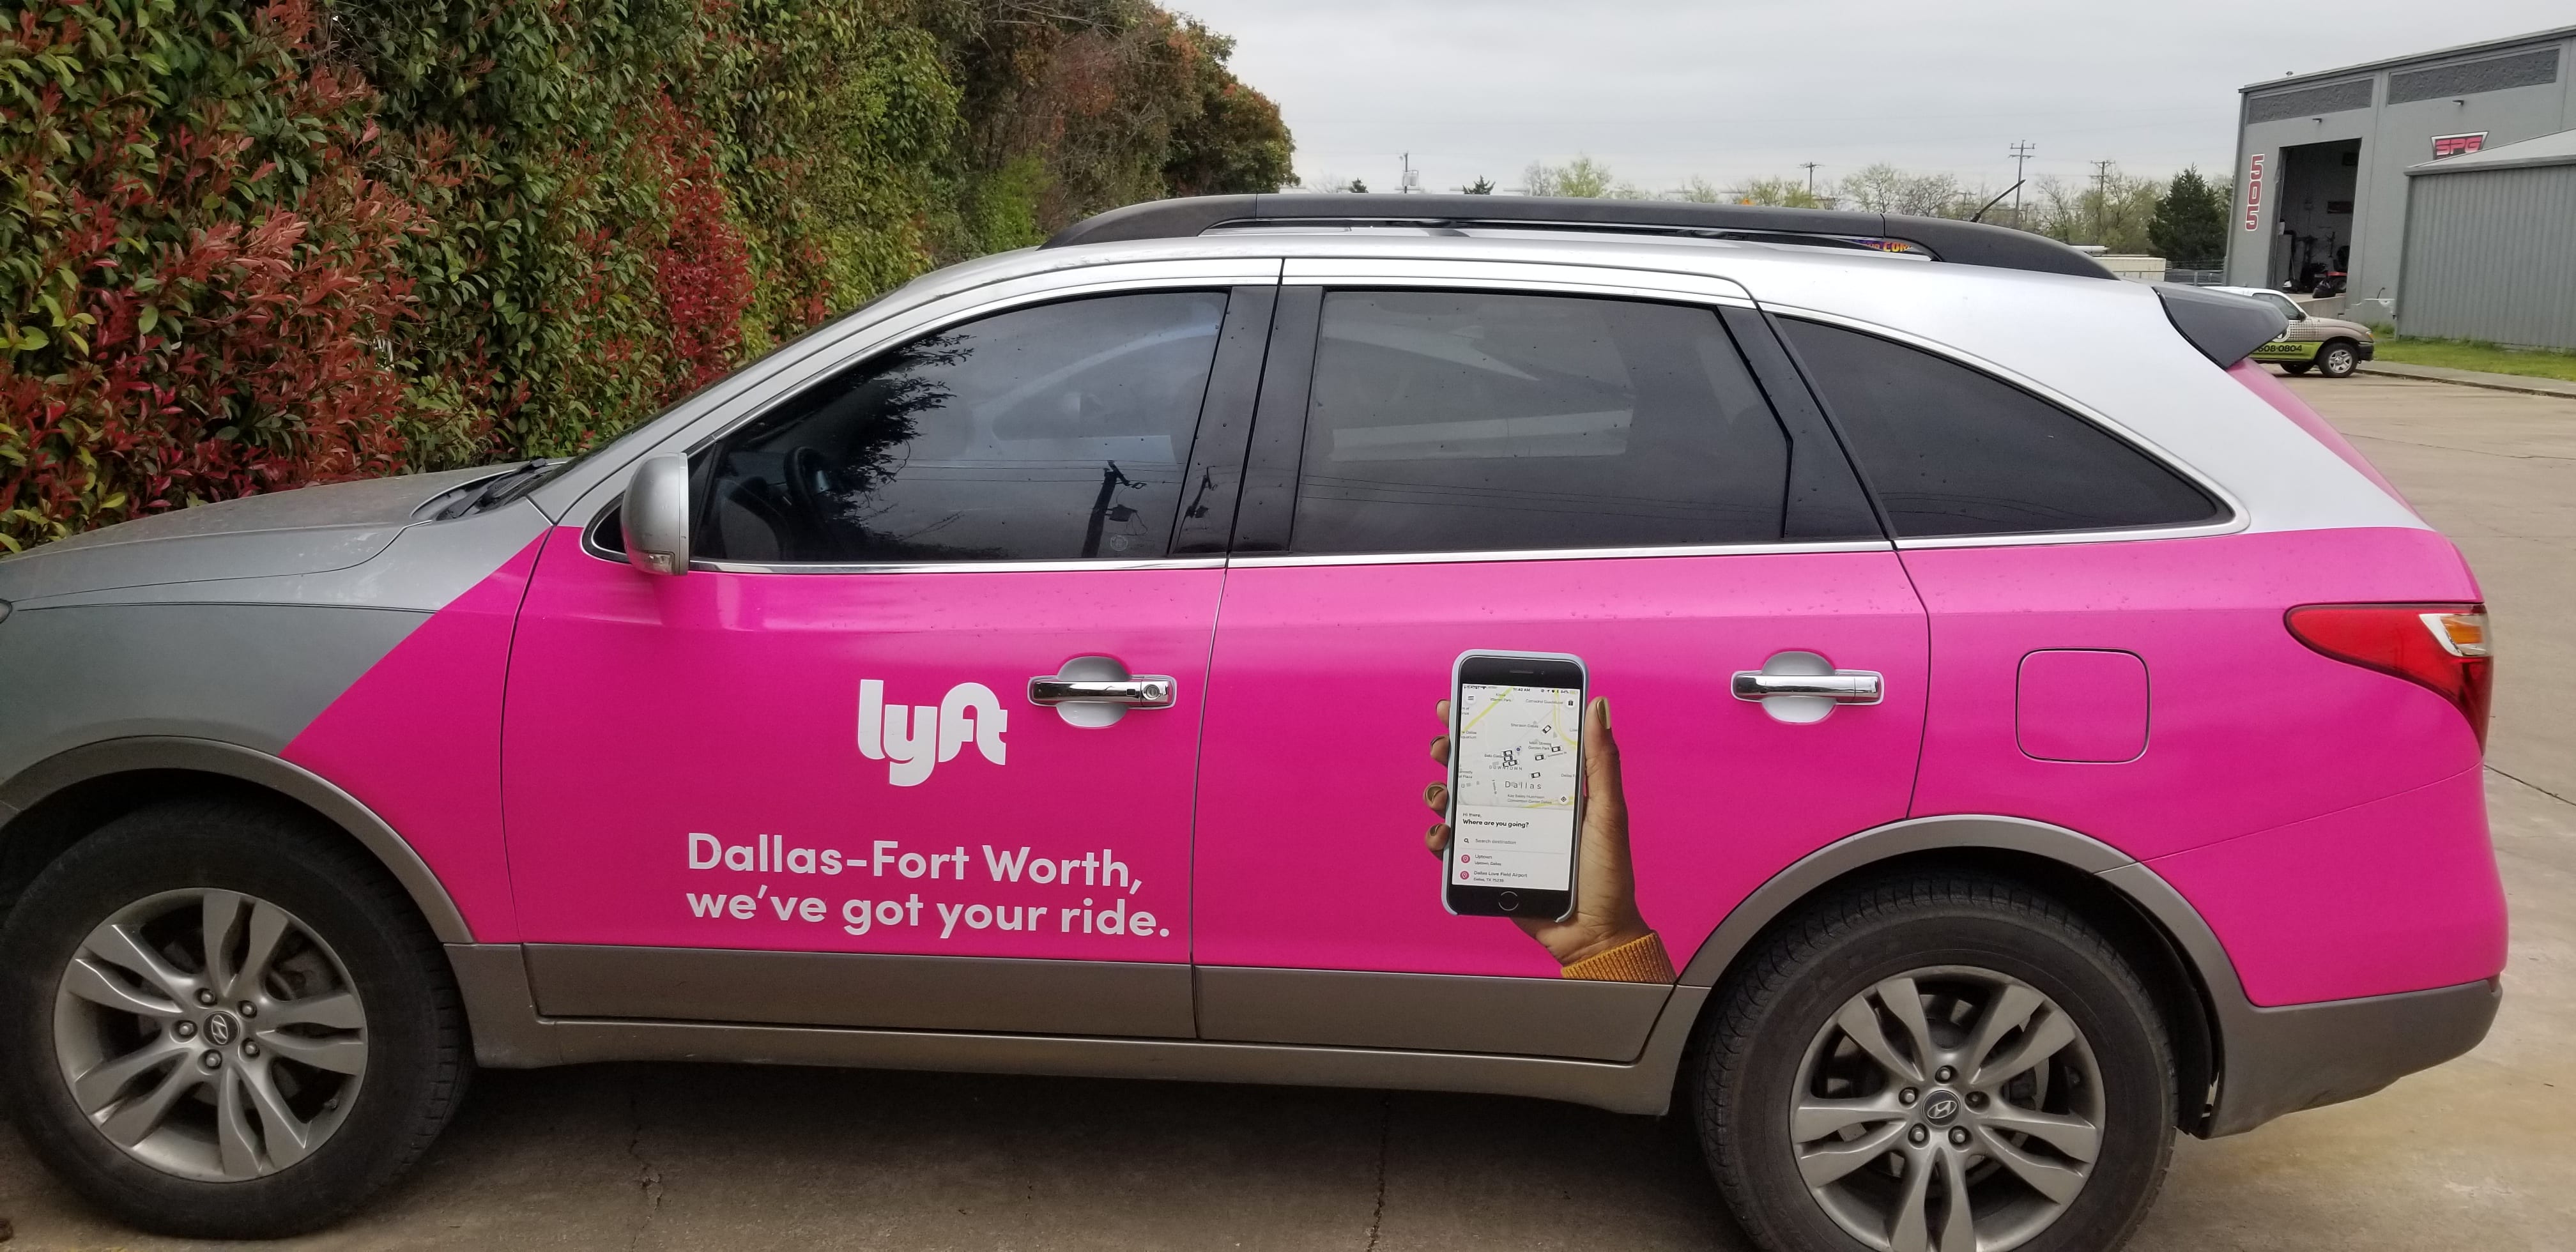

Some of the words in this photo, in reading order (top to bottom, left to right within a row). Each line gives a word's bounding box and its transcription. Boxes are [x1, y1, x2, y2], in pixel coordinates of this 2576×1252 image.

[2435, 136, 2482, 155] SPG
[2245, 154, 2265, 231] 505
[858, 679, 1008, 786] lyft
[1505, 781, 1542, 790] Dallas
[689, 833, 969, 880] Dallas-Fort
[983, 845, 1141, 894] Worth,
[843, 894, 923, 935] got
[937, 903, 1047, 938] your
[1062, 898, 1169, 936] ride.
